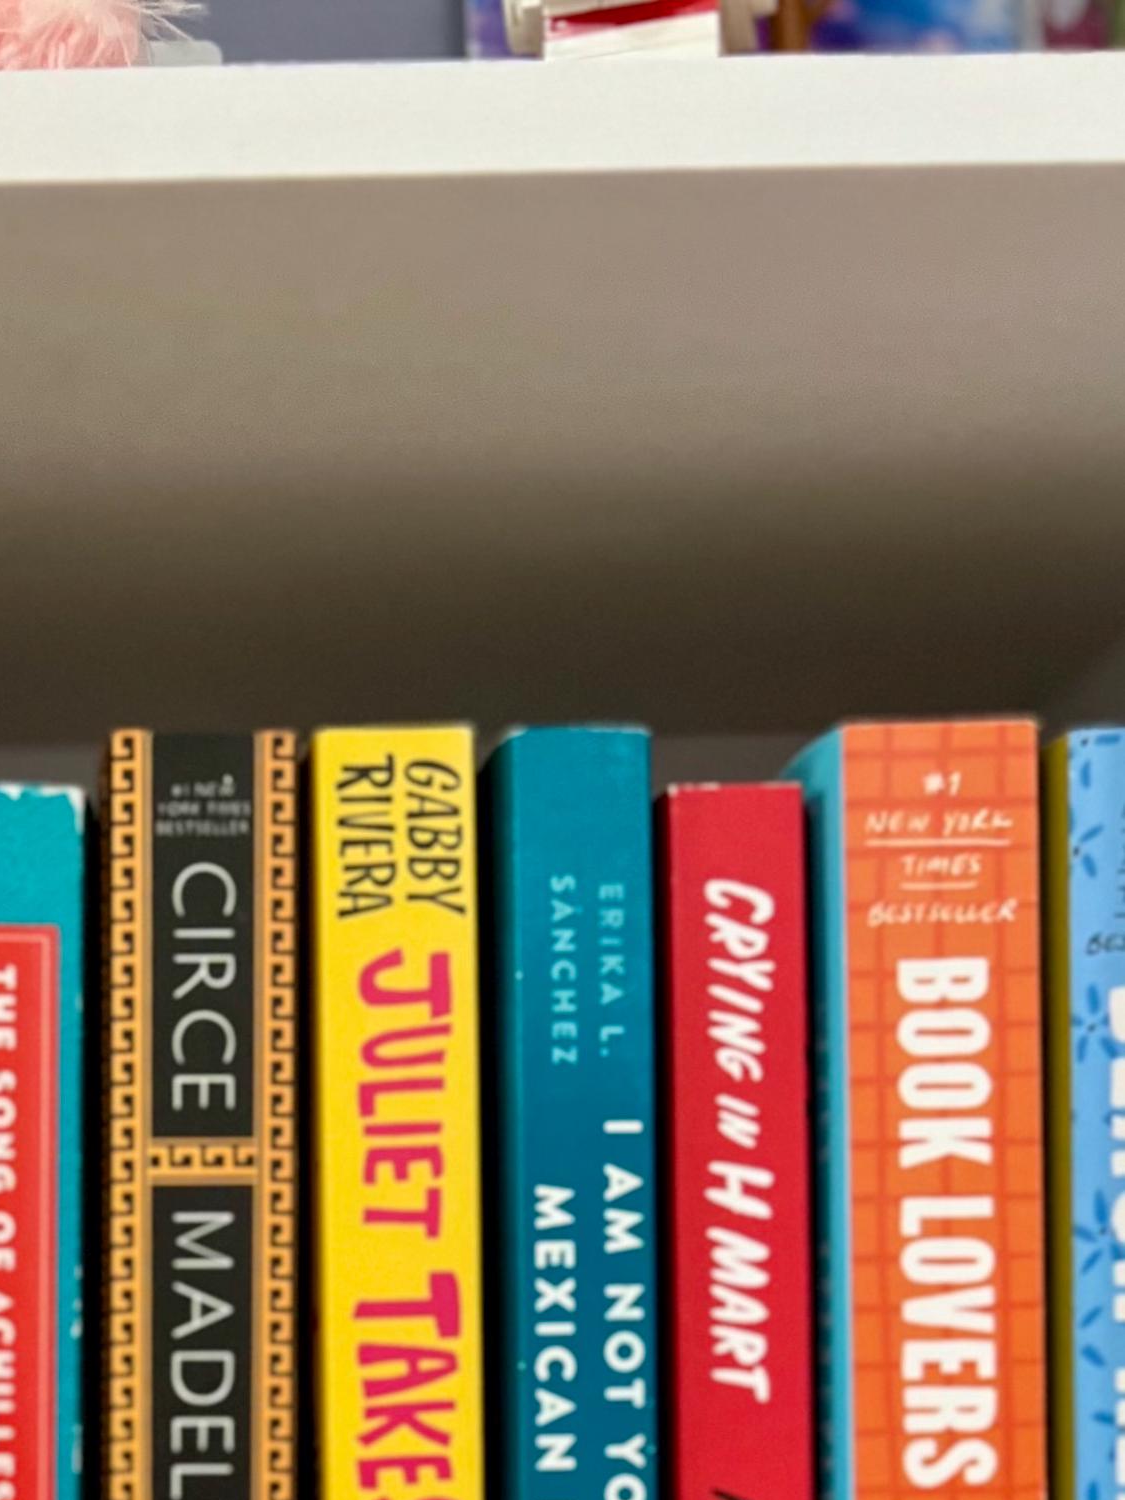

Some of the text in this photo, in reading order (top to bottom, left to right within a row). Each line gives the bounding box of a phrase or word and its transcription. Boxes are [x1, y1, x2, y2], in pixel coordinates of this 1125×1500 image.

[335, 752, 396, 920] RIVERA
[405, 759, 466, 917] GABBY
[865, 807, 1013, 837] NEW YORK
[923, 771, 961, 796] #1
[867, 898, 1017, 928] BESTSELLER
[900, 853, 981, 876] TIMES
[171, 862, 236, 1110] CIRCE
[599, 883, 624, 1059] ERIKA L.
[357, 949, 453, 1239] JULIET
[603, 1120, 643, 1133] I
[703, 878, 775, 1403] CRYING IN H MART
[603, 1163, 643, 1254] AM
[897, 957, 998, 1488] BOOK LOVERS
[534, 1185, 576, 1470] MEXICAN
[603, 1284, 645, 1410] NOT
